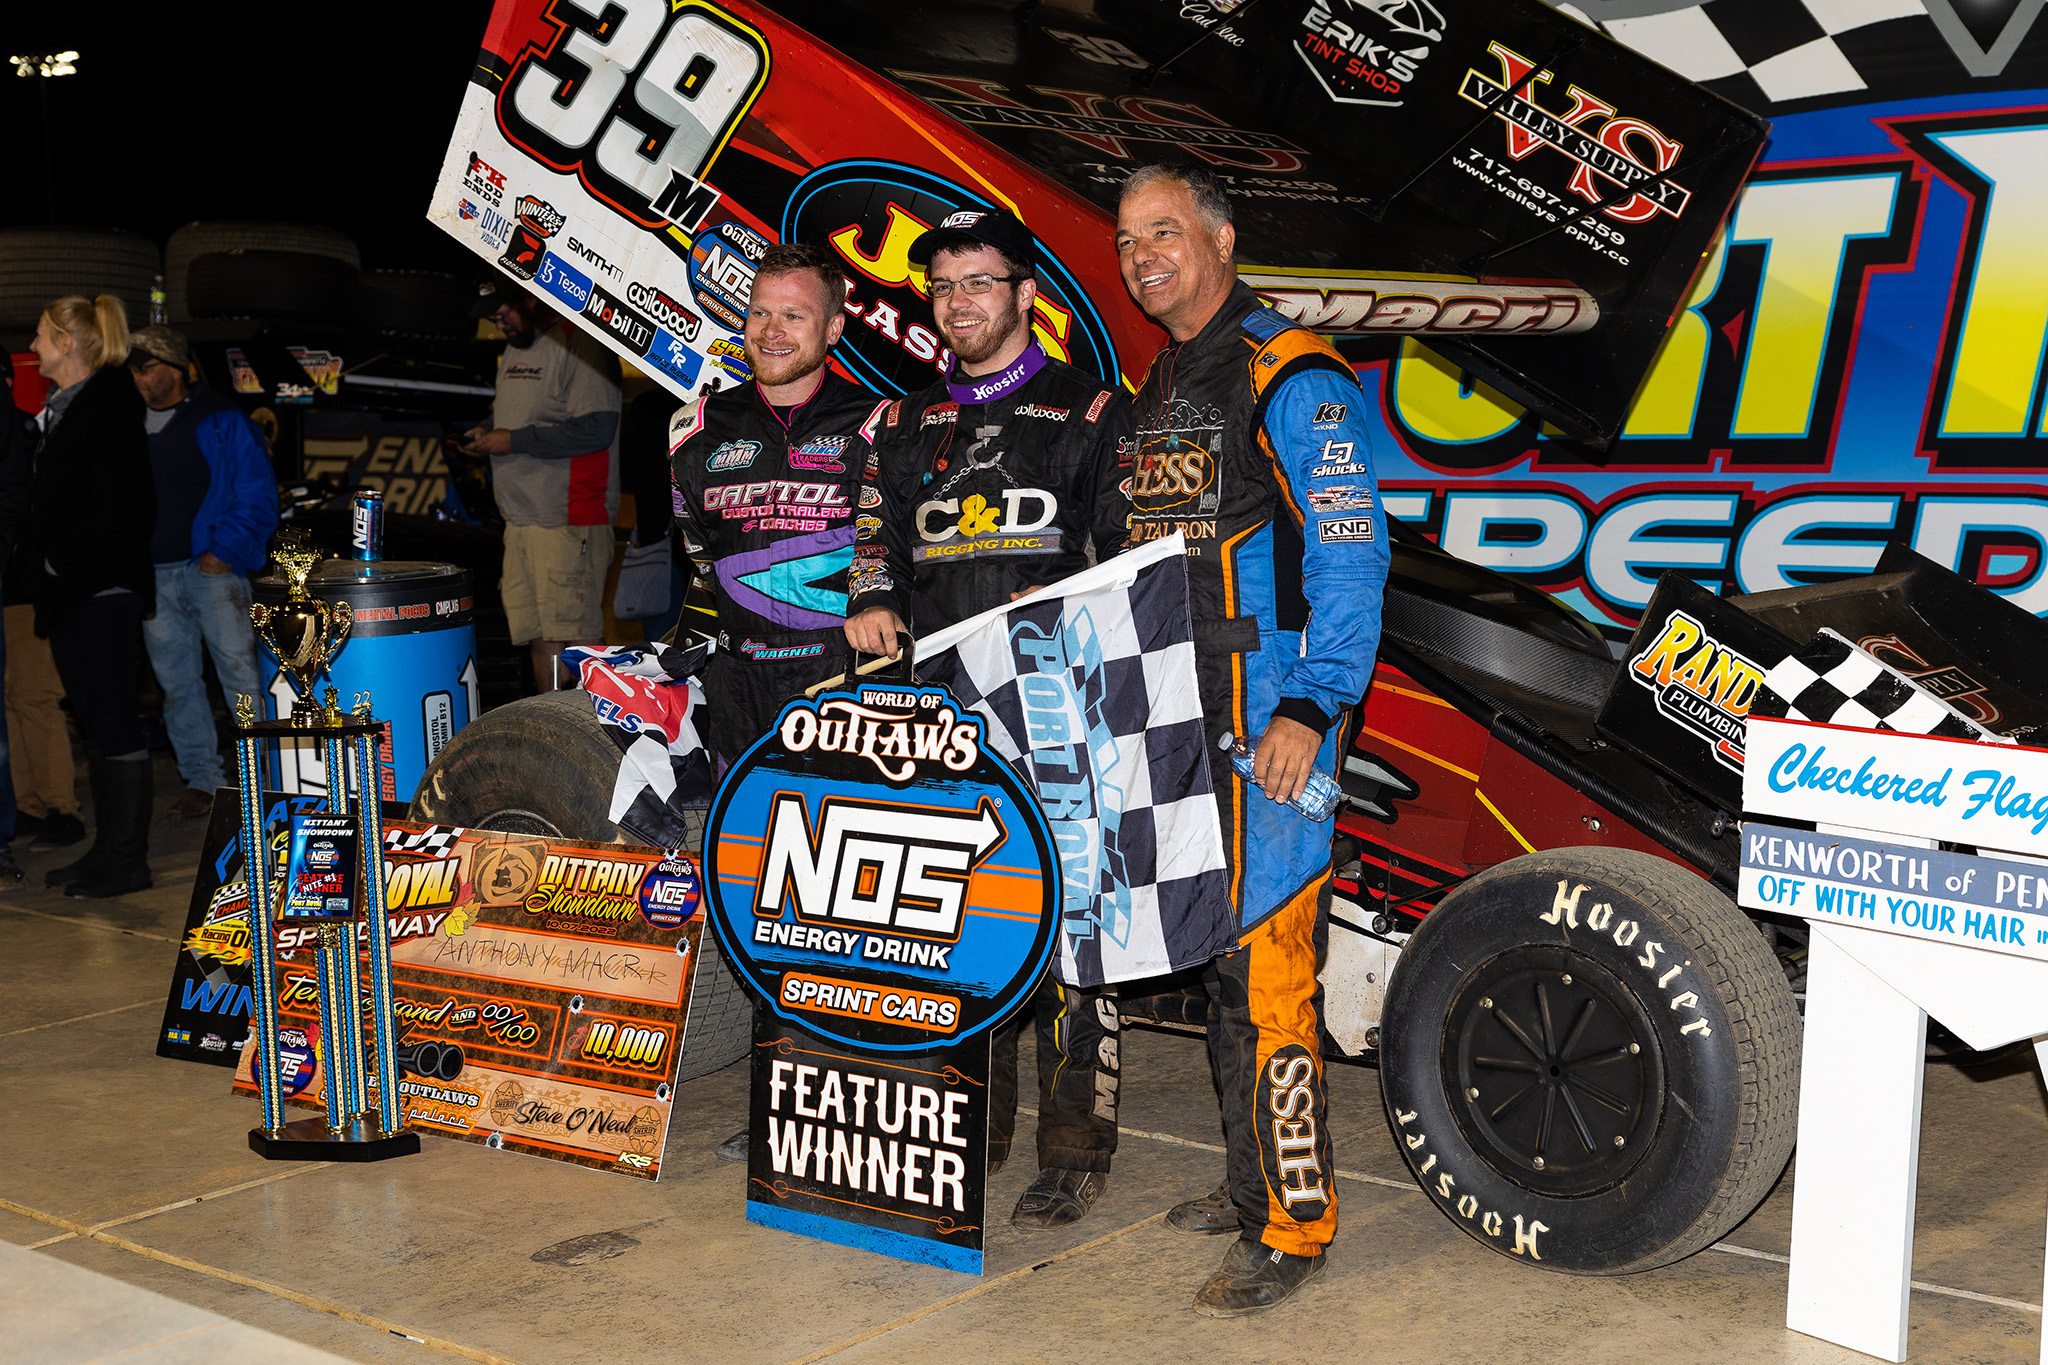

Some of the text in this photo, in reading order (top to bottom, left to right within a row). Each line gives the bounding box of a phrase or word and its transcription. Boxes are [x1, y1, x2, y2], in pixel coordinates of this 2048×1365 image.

[1302, 6, 1419, 82] ERIK'S
[1304, 33, 1401, 94] TINT SHOP
[514, 0, 760, 201] 39
[966, 105, 1282, 151] VALLEY SUPPLY
[462, 177, 501, 208] ENDS
[472, 157, 508, 191] FK
[473, 174, 503, 199] ROD
[481, 207, 513, 244] DIXIE
[559, 270, 587, 301] Tezos
[696, 273, 747, 314] ENERGY DRINK
[587, 294, 629, 337] Mobil
[628, 285, 701, 341] wilwood
[666, 300, 697, 325] RACING
[698, 293, 743, 328] SPRINT CARS
[1254, 289, 1581, 333] Macri
[710, 359, 746, 379] Performance
[972, 364, 1025, 400] Hoosier
[1088, 392, 1110, 420] SIMPSON
[1132, 452, 1205, 496] HESS
[1311, 462, 1367, 478] shocks
[704, 480, 848, 511] CAPITOL
[776, 504, 852, 519] TRAILERS
[353, 503, 368, 549] NOS
[915, 488, 1058, 542] C&D
[1323, 522, 1370, 535] KND
[925, 537, 1042, 558] RIGGING INC.
[355, 608, 398, 622] MENTAL
[400, 604, 430, 618] FOCUS
[753, 644, 825, 659] WAGNER
[1637, 618, 1766, 724] RAND
[863, 691, 942, 709] WORLD OF
[1018, 636, 1083, 780] PORT
[1668, 689, 1746, 746] PLUMBIN
[1768, 743, 2048, 835] Checkered Flag
[310, 850, 335, 862] NOS
[759, 799, 1001, 934] NOS
[1749, 834, 1929, 892] KENWORTH
[1945, 868, 1976, 895] of
[303, 880, 323, 893] NITE
[525, 883, 638, 922] Showdown
[650, 880, 693, 905] NOS
[546, 920, 617, 937] 10.07.2022
[1758, 874, 1806, 907] OFF
[1815, 884, 1876, 921] WITH
[1889, 896, 1955, 934] YOUR
[1963, 909, 2025, 947] HAIR
[201, 929, 231, 943] Racing
[754, 922, 952, 969] ENERGY DRINK
[434, 936, 556, 974] ANTHONY
[1539, 879, 1713, 1038] Hoosier
[450, 1007, 477, 1022] AND
[784, 979, 956, 1026] SPRINT CARS
[584, 1022, 666, 1064] 10,000
[399, 1083, 480, 1106] OUTLAWS
[769, 1059, 968, 1148] FEATURE
[409, 1108, 471, 1128] palace
[516, 1101, 638, 1135] Steve O'Neal
[1270, 1056, 1329, 1209] HESS
[617, 1151, 654, 1169] KRS
[767, 1116, 965, 1212] WINNER
[1395, 1107, 1549, 1261] Hoosier
